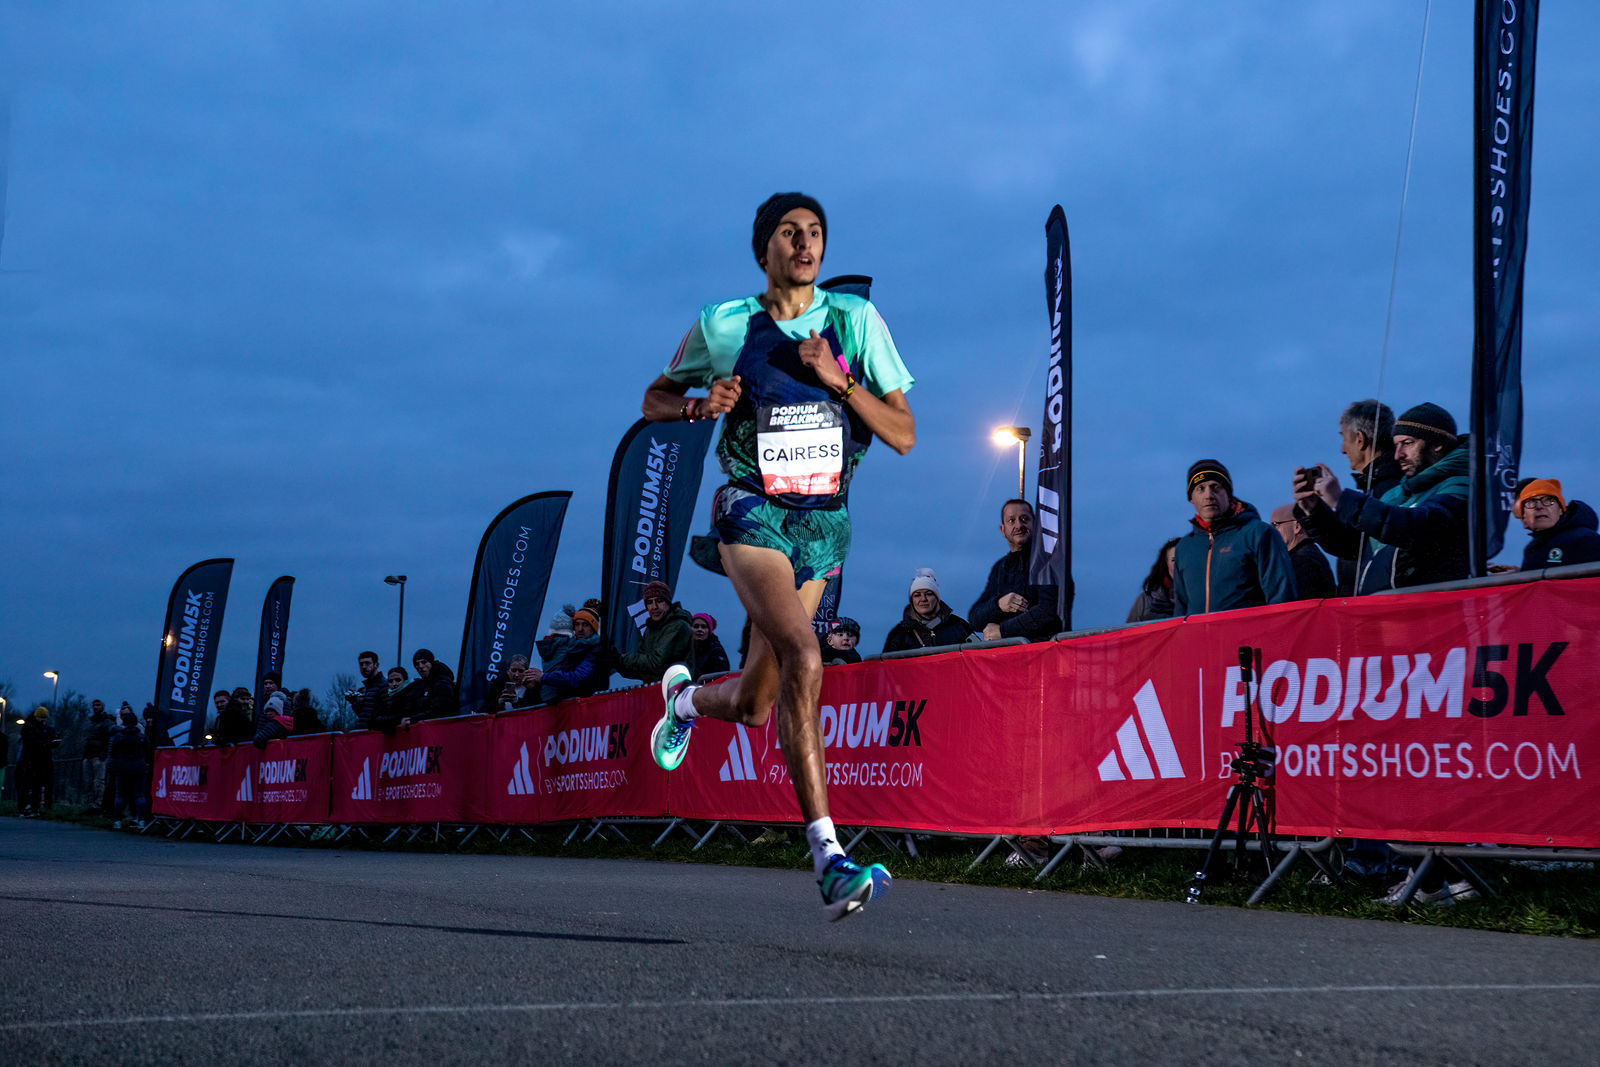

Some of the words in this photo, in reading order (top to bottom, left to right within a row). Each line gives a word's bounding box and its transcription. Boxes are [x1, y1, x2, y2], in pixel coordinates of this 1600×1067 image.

[769, 412, 825, 426] BREAKING
[771, 404, 819, 416] PODIUM
[763, 443, 840, 462] CAIRESS
[631, 437, 668, 575] PODIUM5K
[653, 442, 681, 562] SPORTSSHOES.COM
[650, 562, 660, 578] BY
[486, 525, 532, 682] SPORTSSHOES.COM
[171, 588, 203, 704] PODIUM5K
[190, 591, 215, 692] SPORTSSHOES.COM
[1221, 641, 1570, 727] PODIUM5K
[544, 722, 630, 767] PODIUM5K
[775, 699, 928, 749] DIUM5K
[379, 746, 443, 779] PODIUM5K
[769, 764, 787, 785] BY
[1218, 750, 1240, 779] B
